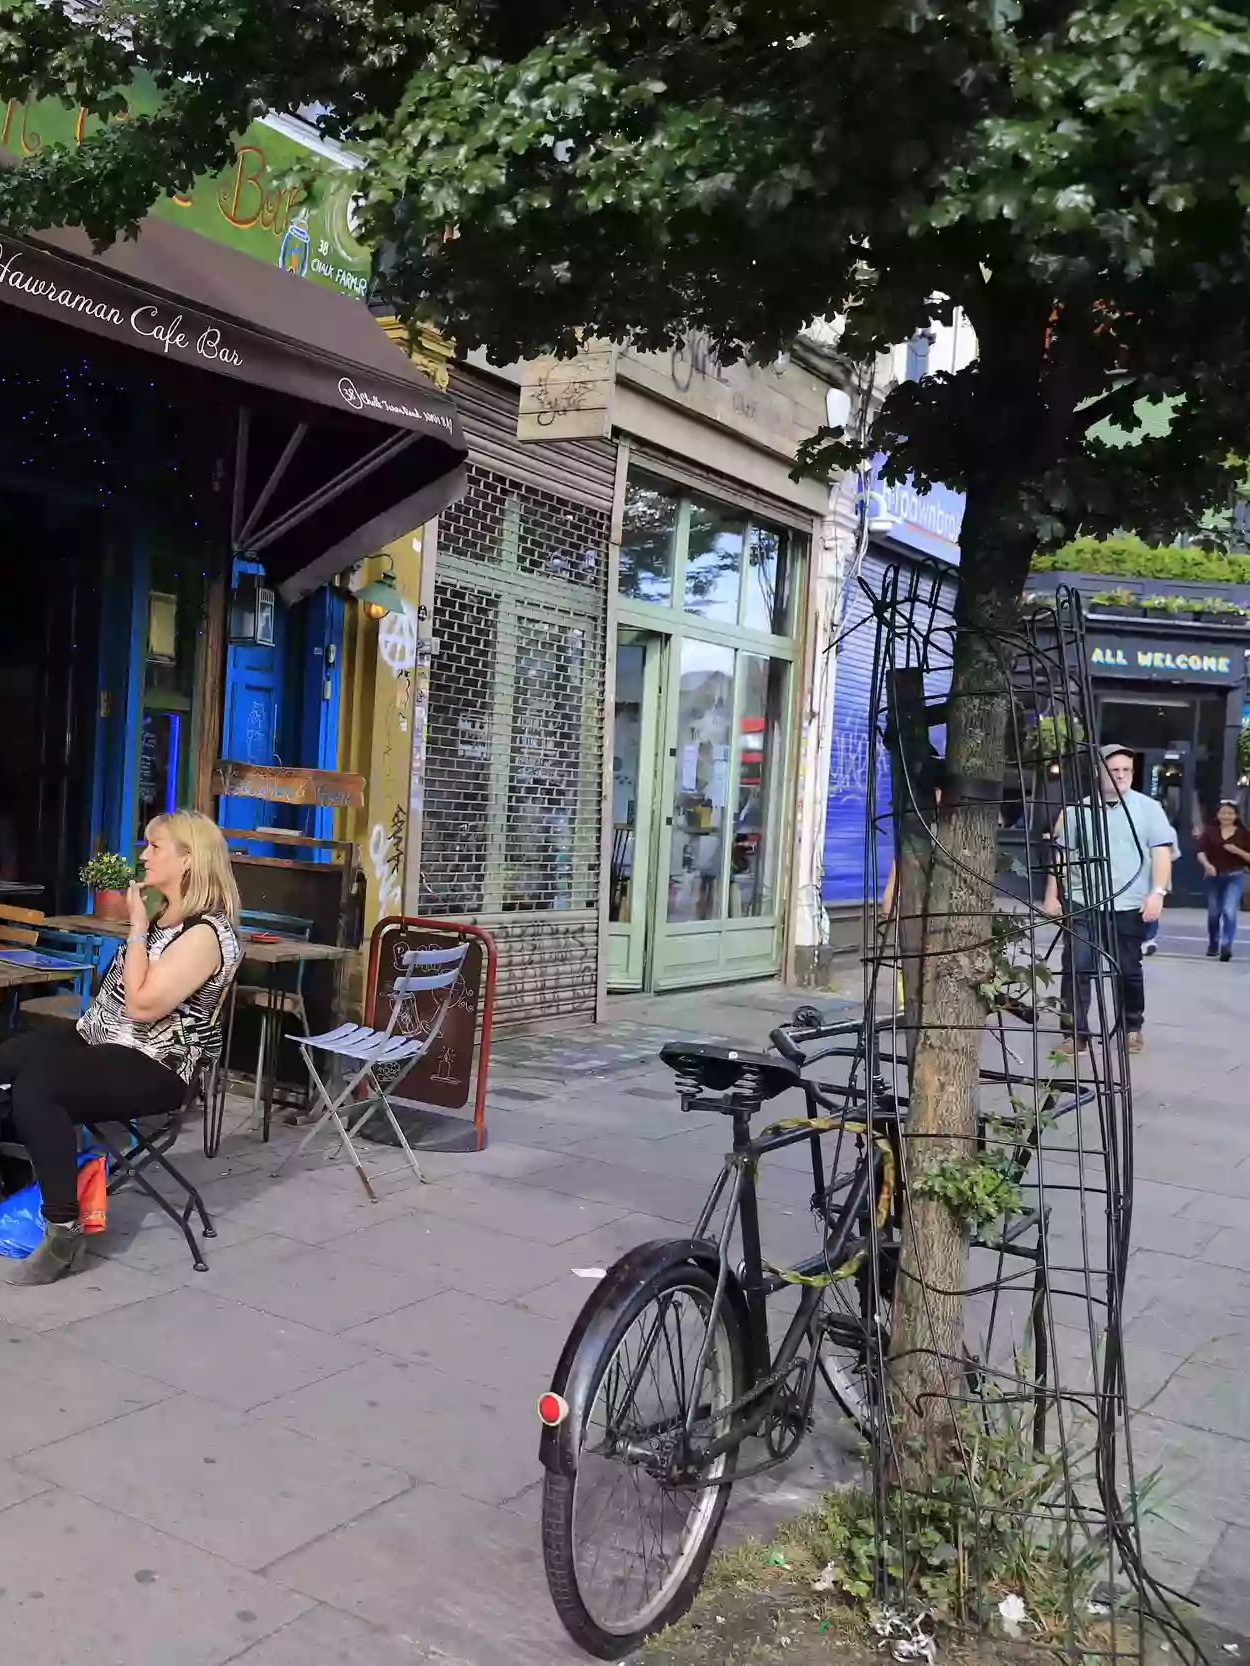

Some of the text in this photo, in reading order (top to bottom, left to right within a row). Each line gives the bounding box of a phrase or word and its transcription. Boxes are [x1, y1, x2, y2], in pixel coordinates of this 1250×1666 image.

[317, 239, 329, 256] 38
[310, 258, 334, 279] CHALK
[130, 305, 189, 352] Cafe
[196, 326, 243, 367] Bar
[342, 387, 356, 401] 38
[1091, 647, 1231, 673] ALL WELCOME
